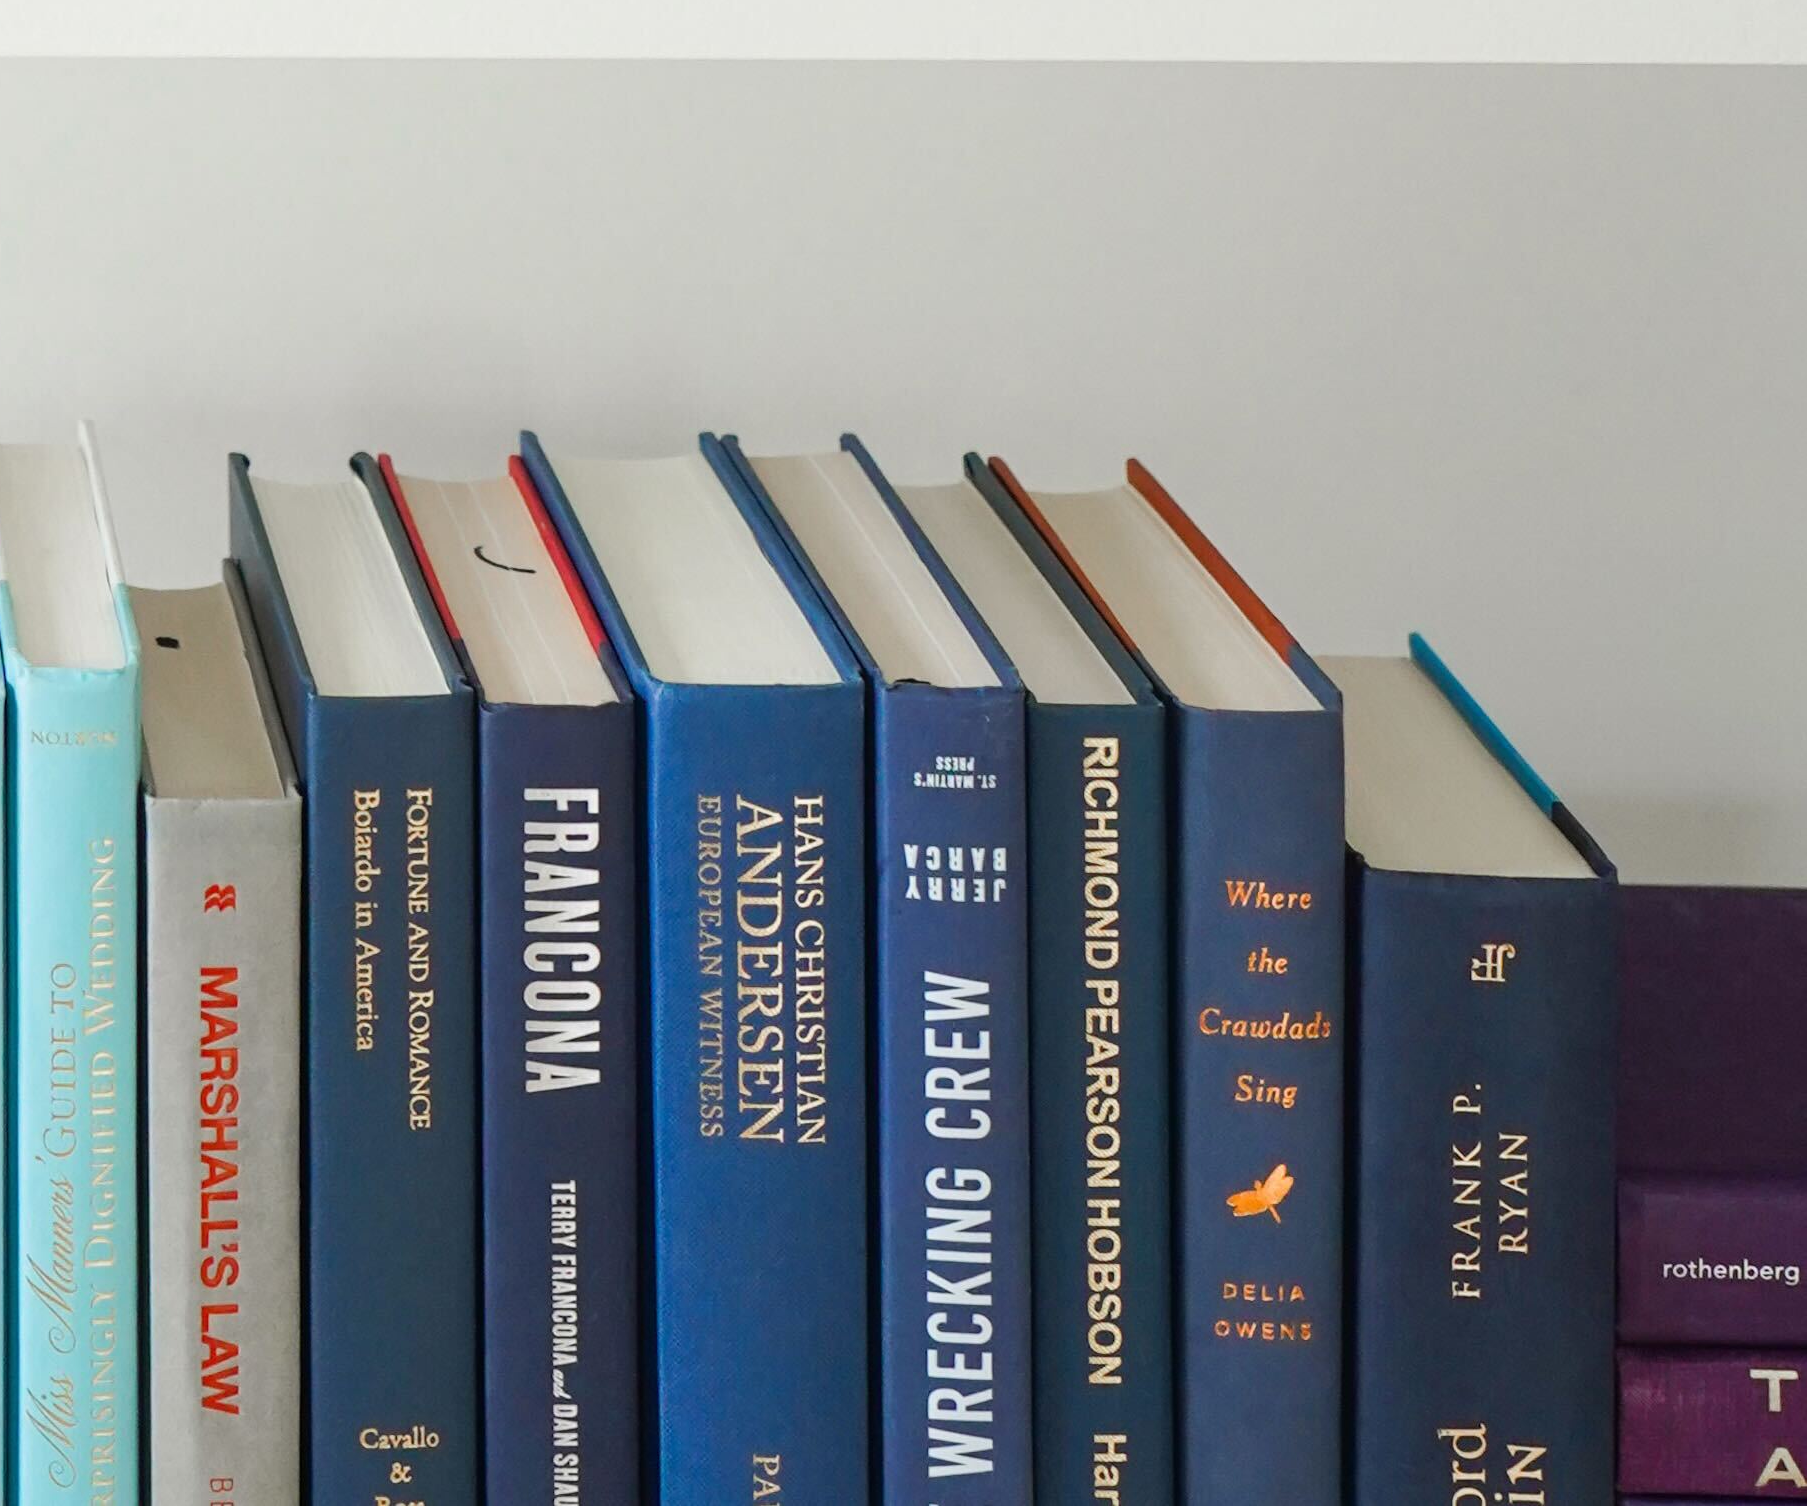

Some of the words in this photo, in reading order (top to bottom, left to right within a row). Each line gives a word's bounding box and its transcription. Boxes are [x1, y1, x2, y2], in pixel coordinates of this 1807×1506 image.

[935, 755, 975, 772] PRESS
[353, 789, 381, 894] Boiardo
[405, 787, 433, 913] FORTUNE
[697, 794, 723, 977] EUROPEAN
[793, 794, 825, 909] HANS
[903, 843, 1007, 872] BARCA
[905, 875, 1007, 903] JERRY
[1082, 736, 1121, 970] RICHMOND
[1226, 879, 1313, 910] Where
[82, 836, 117, 1037] WEDDING
[355, 937, 382, 1052] America
[407, 922, 430, 982] AND
[523, 787, 602, 1093] FRANCONA
[735, 794, 785, 1144] ANDERSEN
[407, 989, 434, 1130] ROMANCE
[698, 987, 725, 1138] WITNESS
[794, 919, 828, 1145] CHRISTIAN
[923, 969, 992, 1140] CREW
[1084, 979, 1122, 1189] PEARSON
[199, 966, 240, 1288] MARSHALL'S
[1452, 1081, 1482, 1115] P.
[551, 1179, 577, 1249] TERRY
[1451, 1140, 1482, 1299] FRANK
[1497, 1131, 1529, 1255] RYAN
[551, 1254, 579, 1366] FRANCONA
[925, 1166, 994, 1479] WRECKING
[1086, 1197, 1123, 1385] HOBSON
[1662, 1258, 1801, 1287] rothenberg
[200, 1304, 241, 1415] LAW
[359, 1425, 441, 1450] Cavallo
[553, 1403, 579, 1448] DAN
